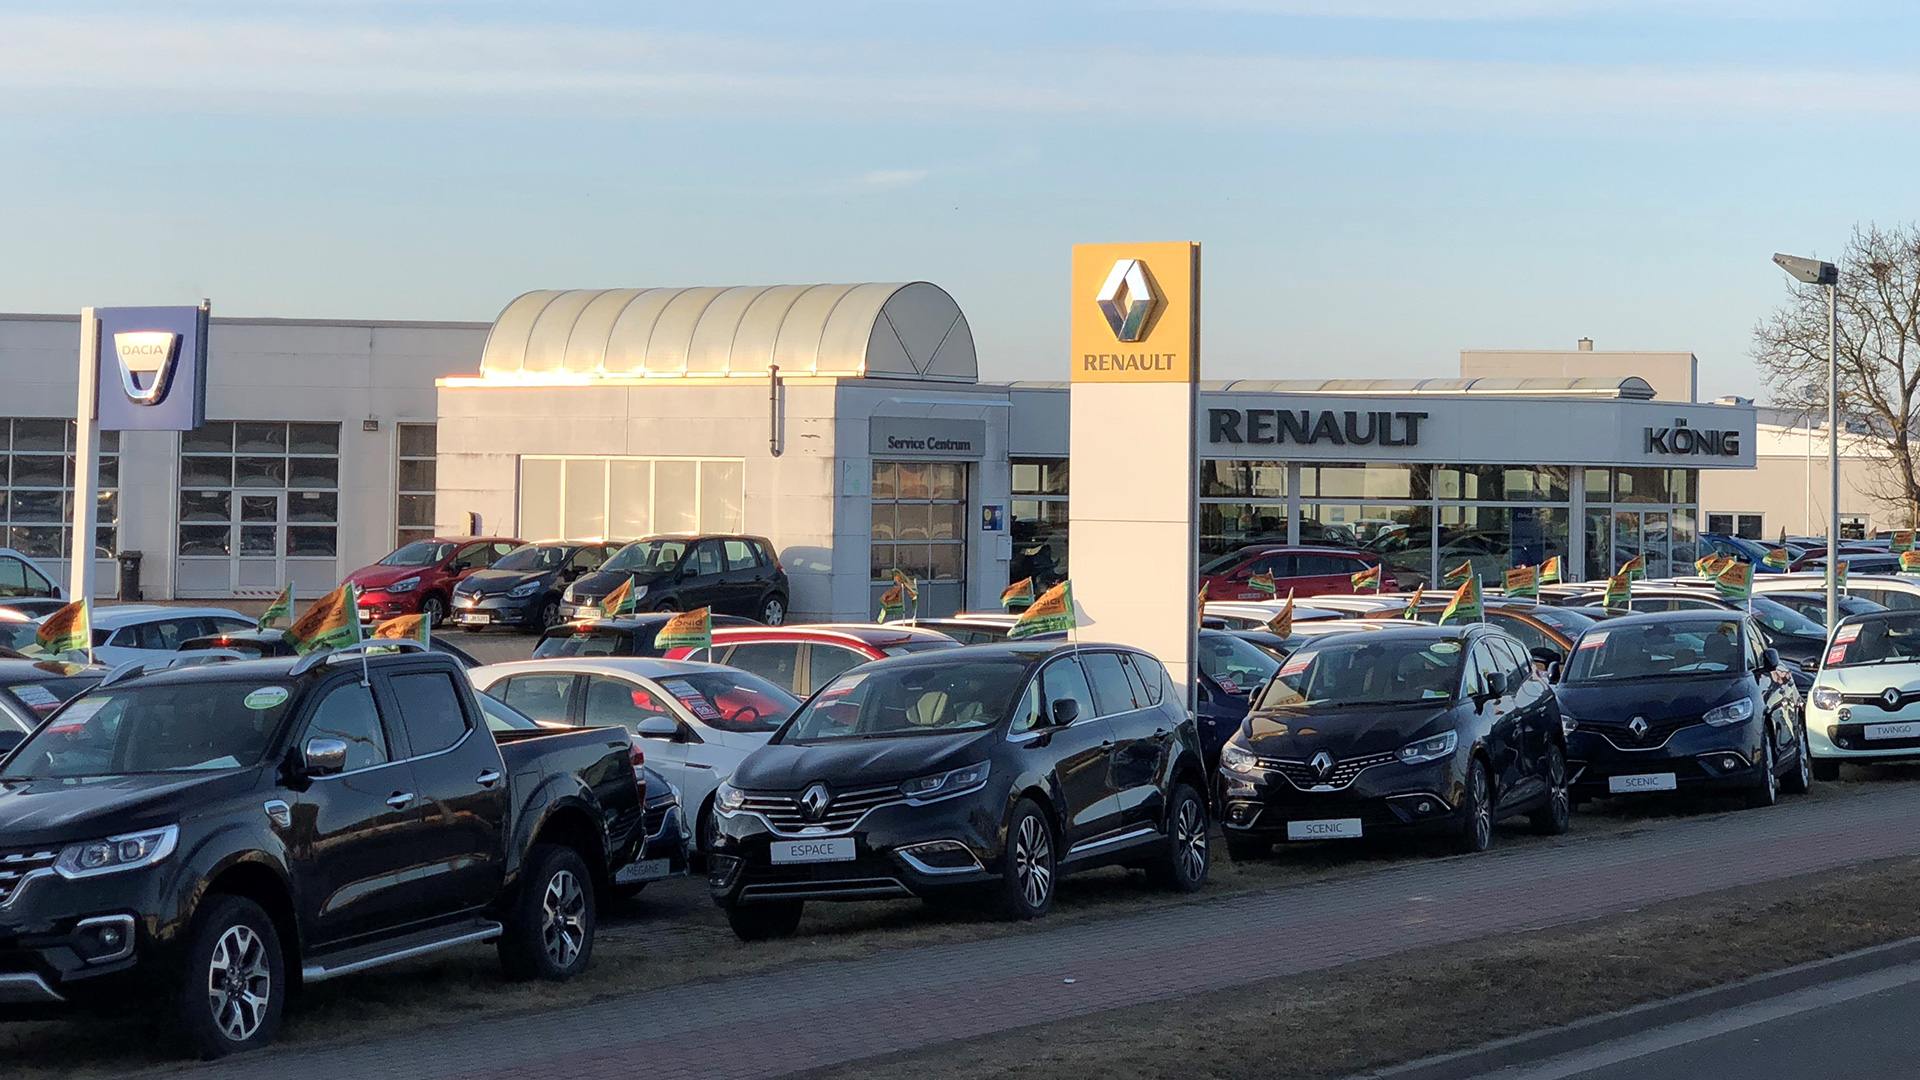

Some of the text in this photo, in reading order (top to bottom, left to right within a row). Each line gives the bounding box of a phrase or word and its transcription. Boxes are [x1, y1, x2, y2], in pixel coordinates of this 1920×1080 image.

[122, 345, 163, 355] DACIA
[1083, 353, 1176, 371] RENAULT
[1208, 408, 1428, 446] RENAULT
[888, 435, 971, 451] Service Centrum
[1644, 418, 1740, 456] KÖNIG
[1876, 725, 1912, 735] TWINGO
[1625, 777, 1659, 787] SCENIC
[1305, 823, 1343, 834] SCENIC
[790, 843, 835, 857] ESPACE
[626, 863, 660, 876] MEGANE
